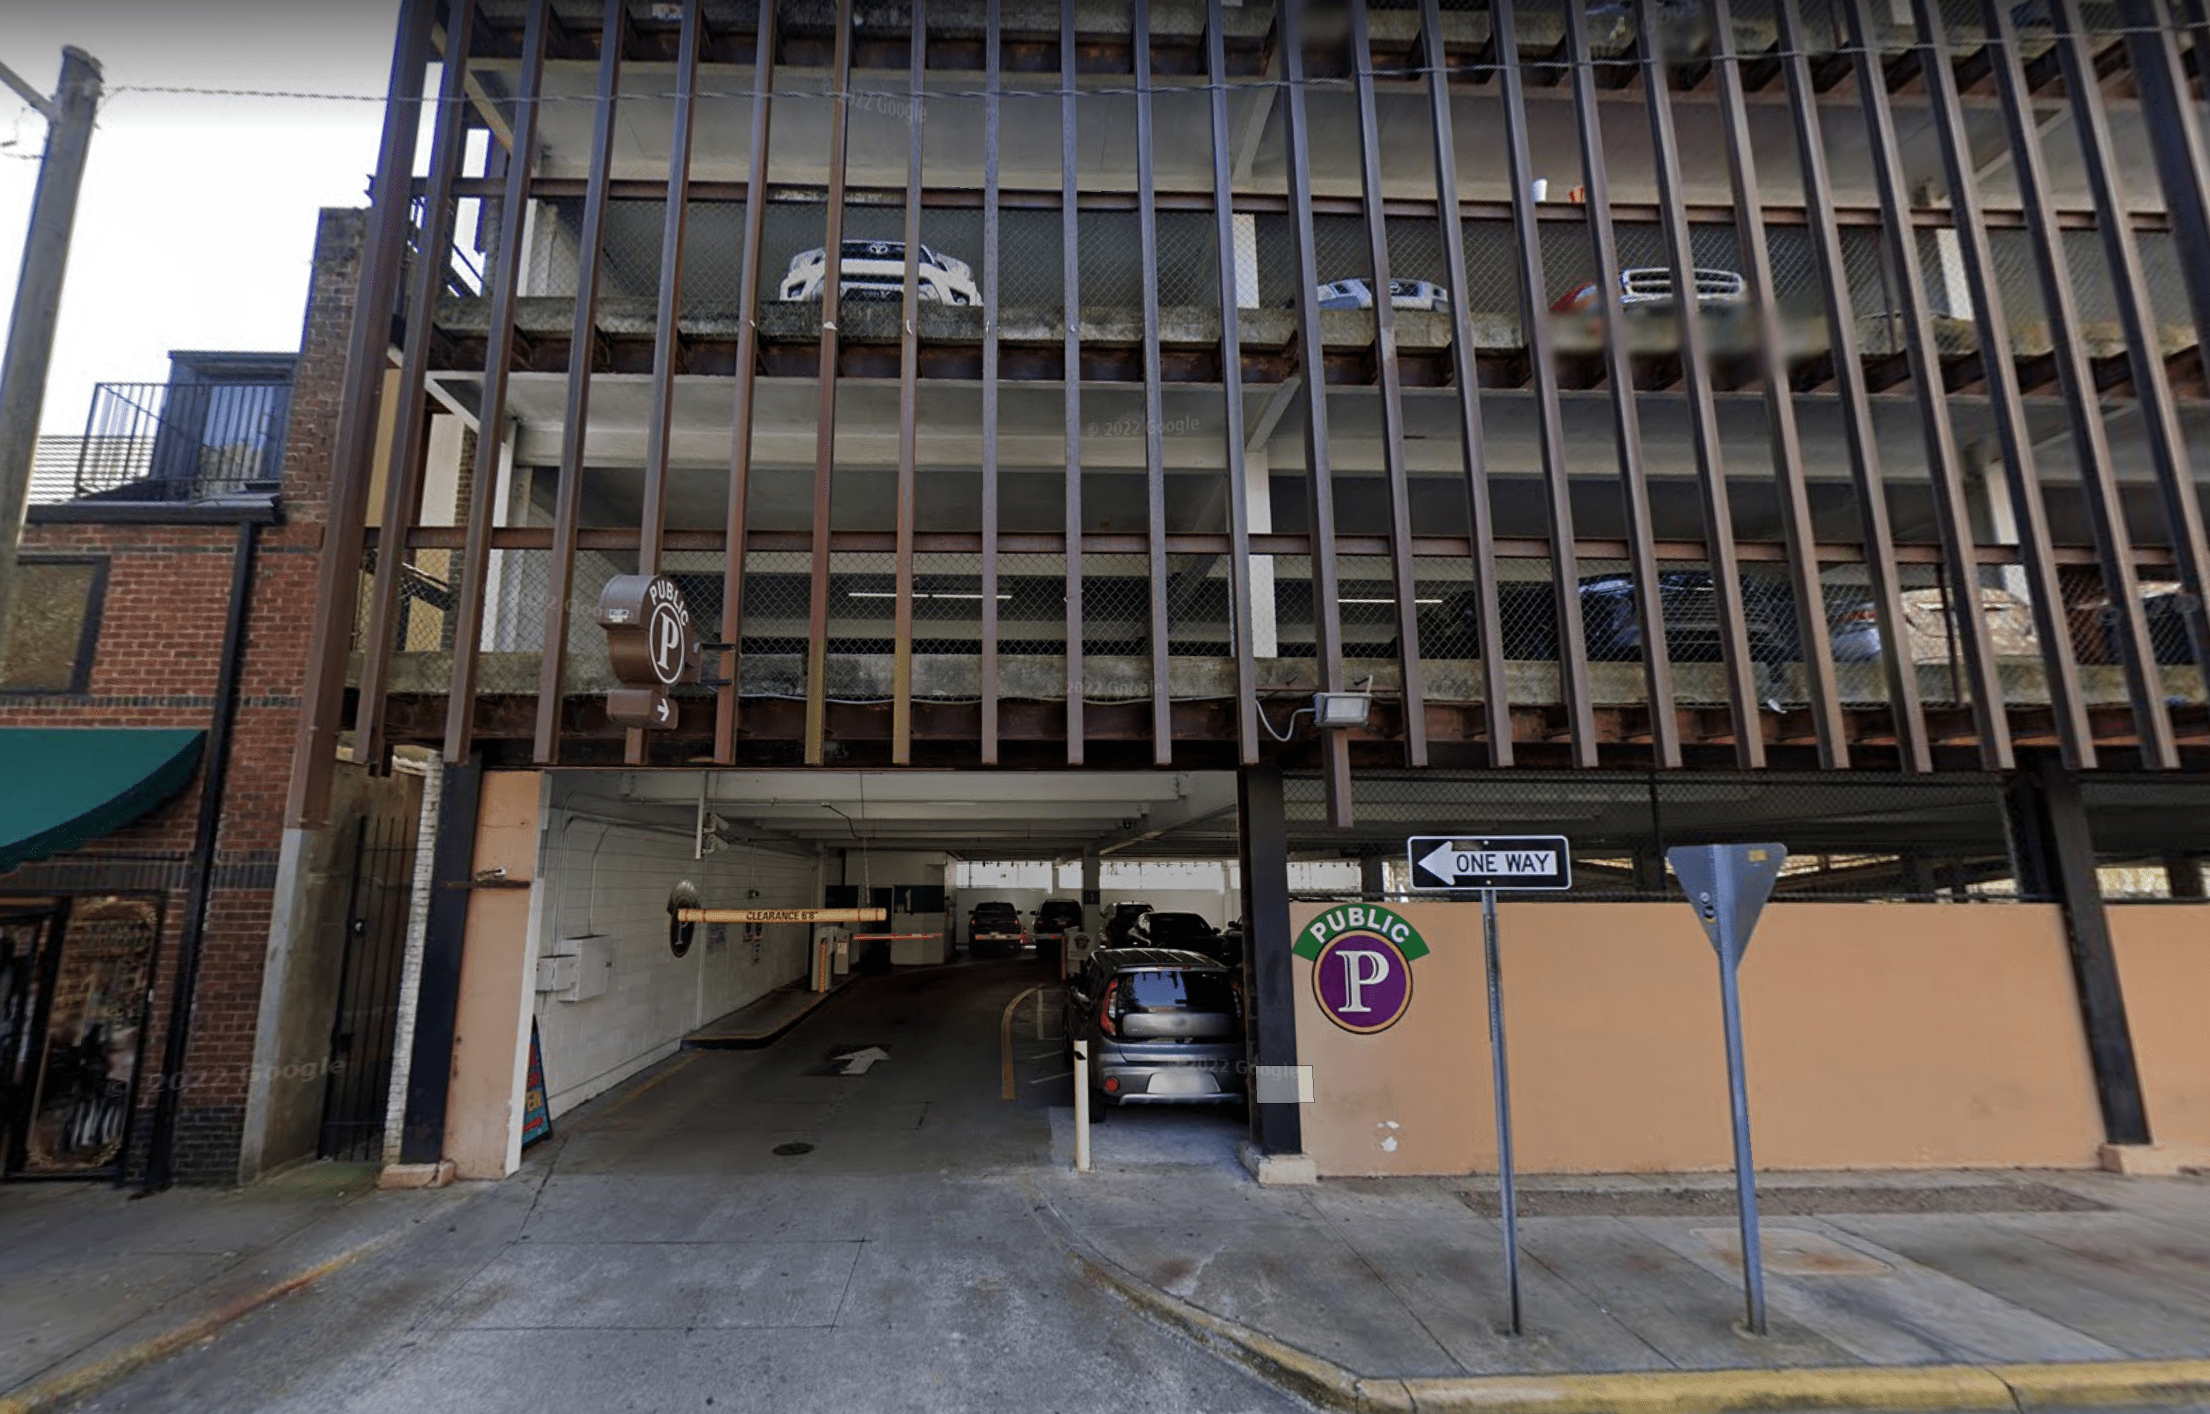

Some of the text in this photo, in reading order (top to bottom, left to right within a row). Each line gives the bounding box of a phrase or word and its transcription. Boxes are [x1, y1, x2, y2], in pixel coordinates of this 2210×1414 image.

[650, 580, 689, 627] PUBLIC
[657, 611, 679, 671] P
[1456, 853, 1550, 873] ONE WAY
[746, 911, 799, 921] CLEARANCE
[1309, 907, 1411, 944] PUBLIC
[1335, 950, 1390, 1013] P
